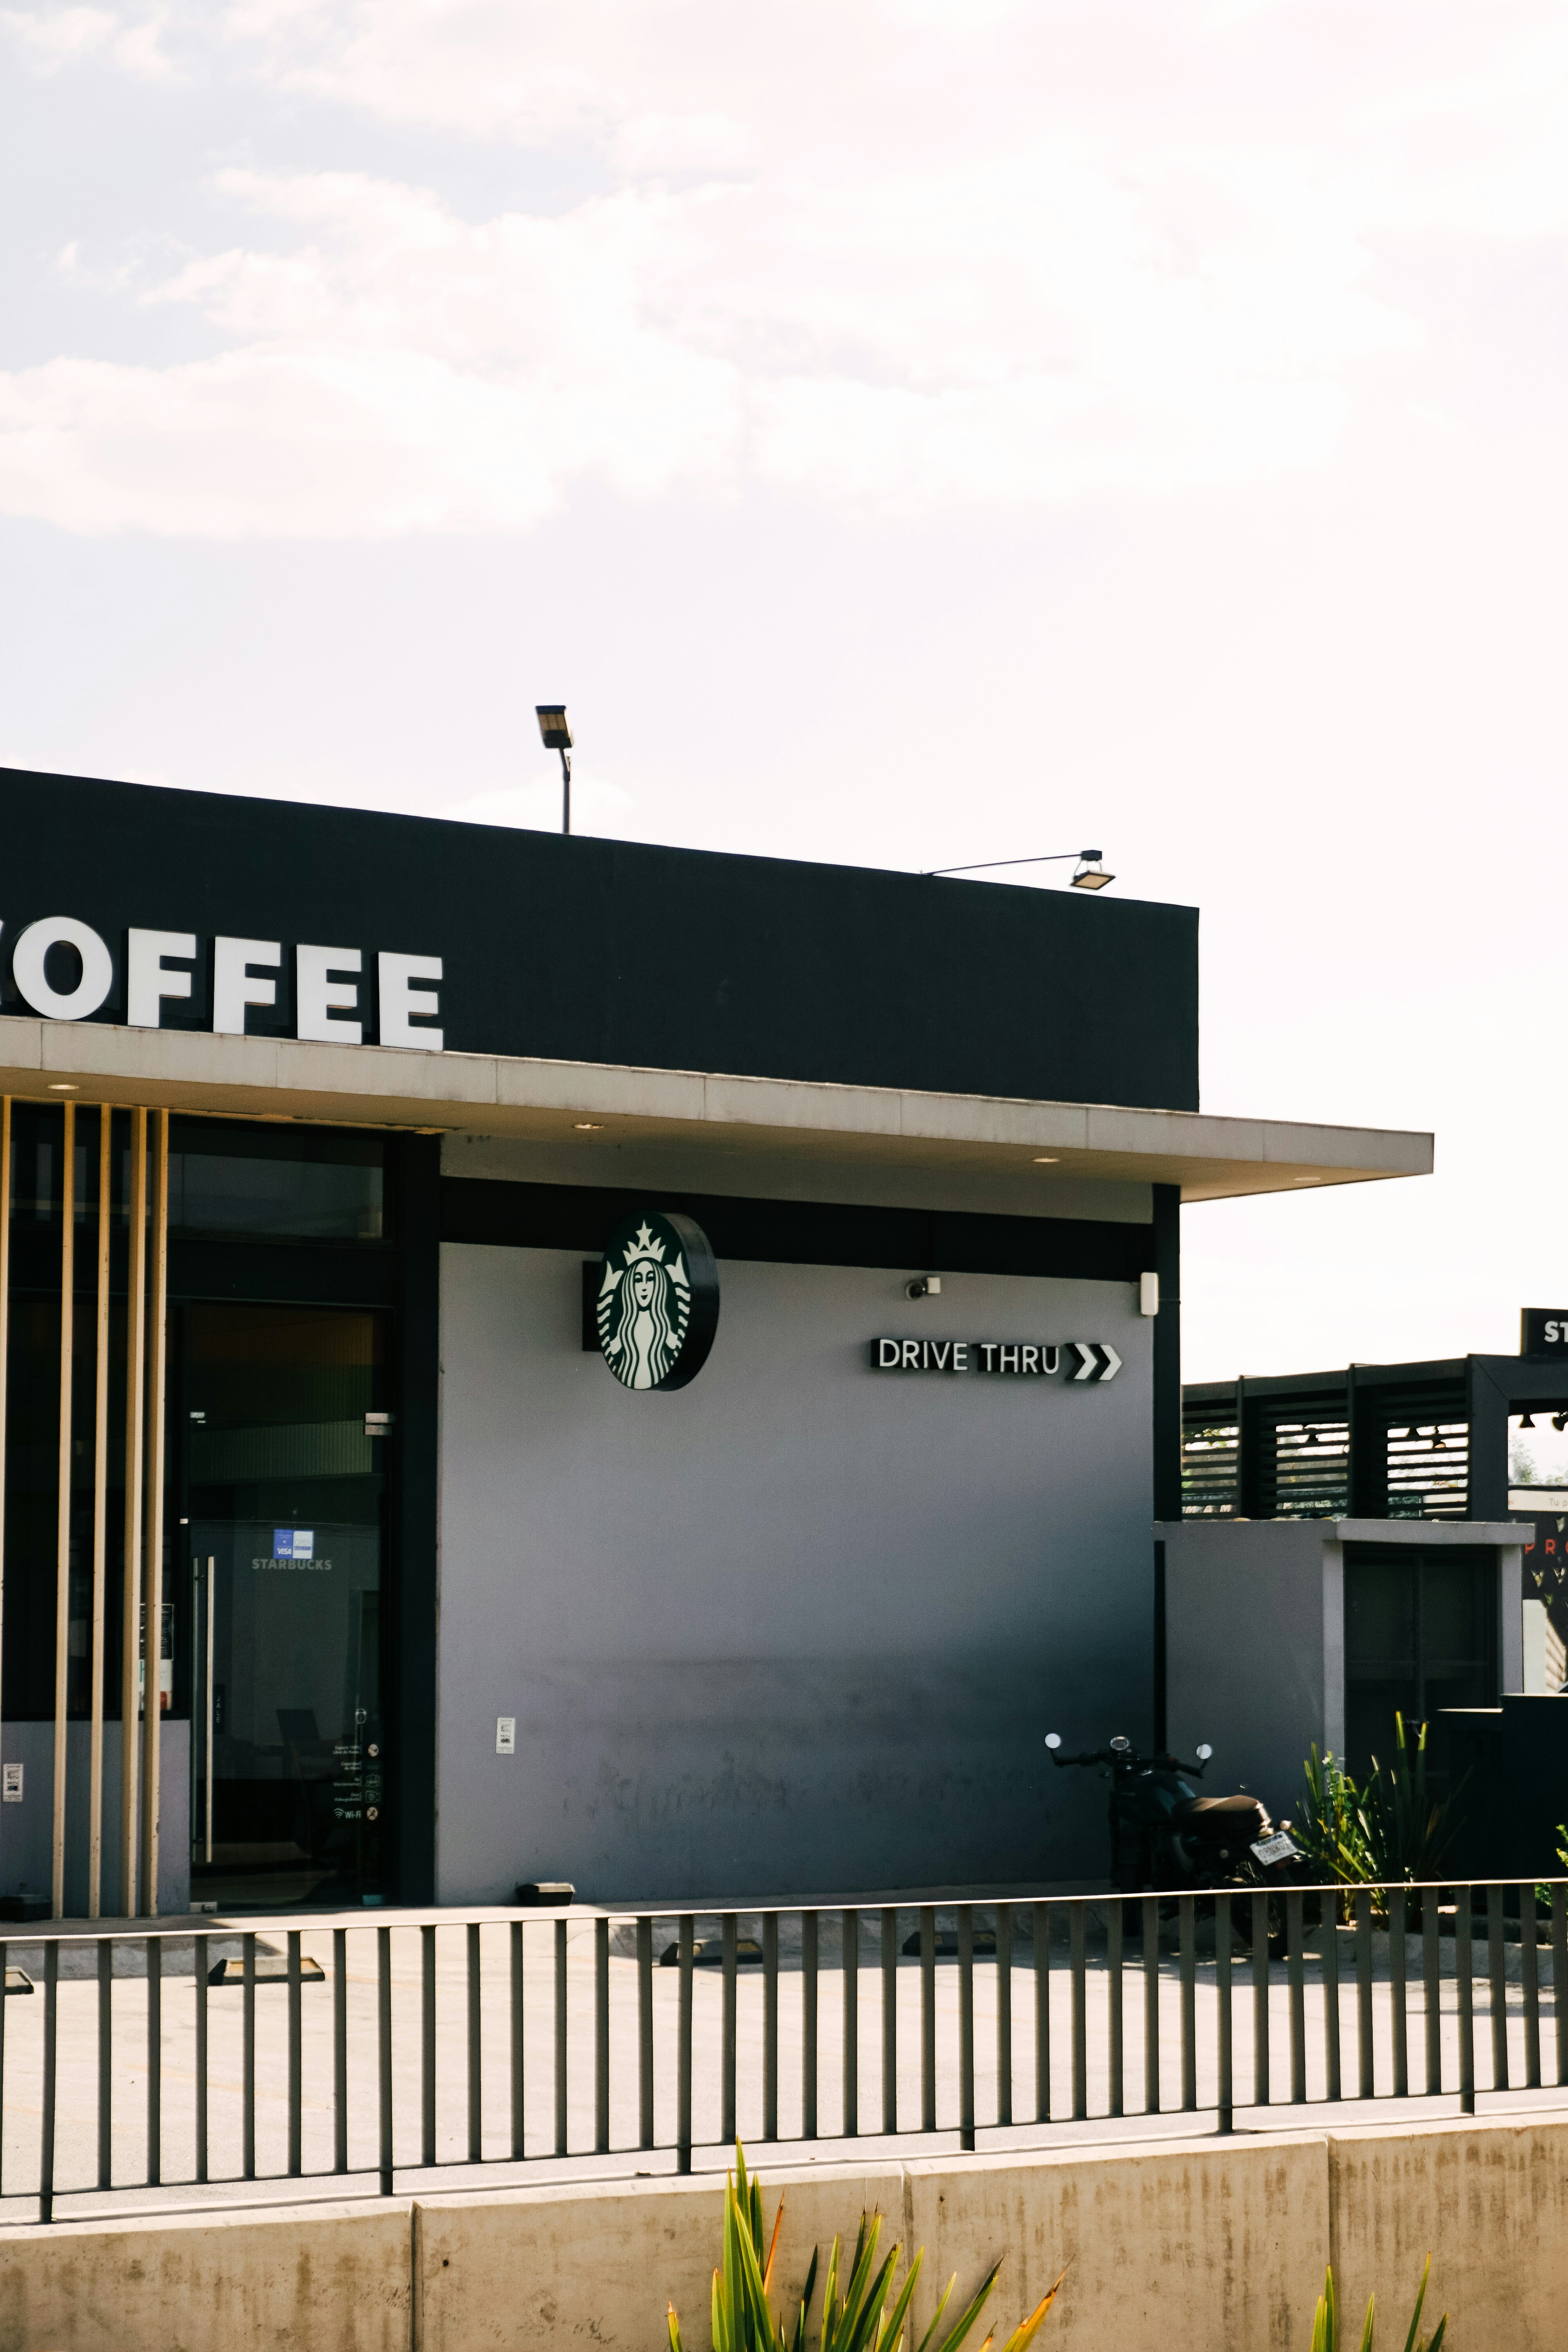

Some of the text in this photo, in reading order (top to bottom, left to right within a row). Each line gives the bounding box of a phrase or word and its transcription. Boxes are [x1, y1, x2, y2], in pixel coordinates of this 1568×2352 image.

[0, 916, 443, 1051] OFFEE
[879, 1339, 1059, 1374] DRIVE THRU
[252, 1559, 332, 1570] STARBUCKS
